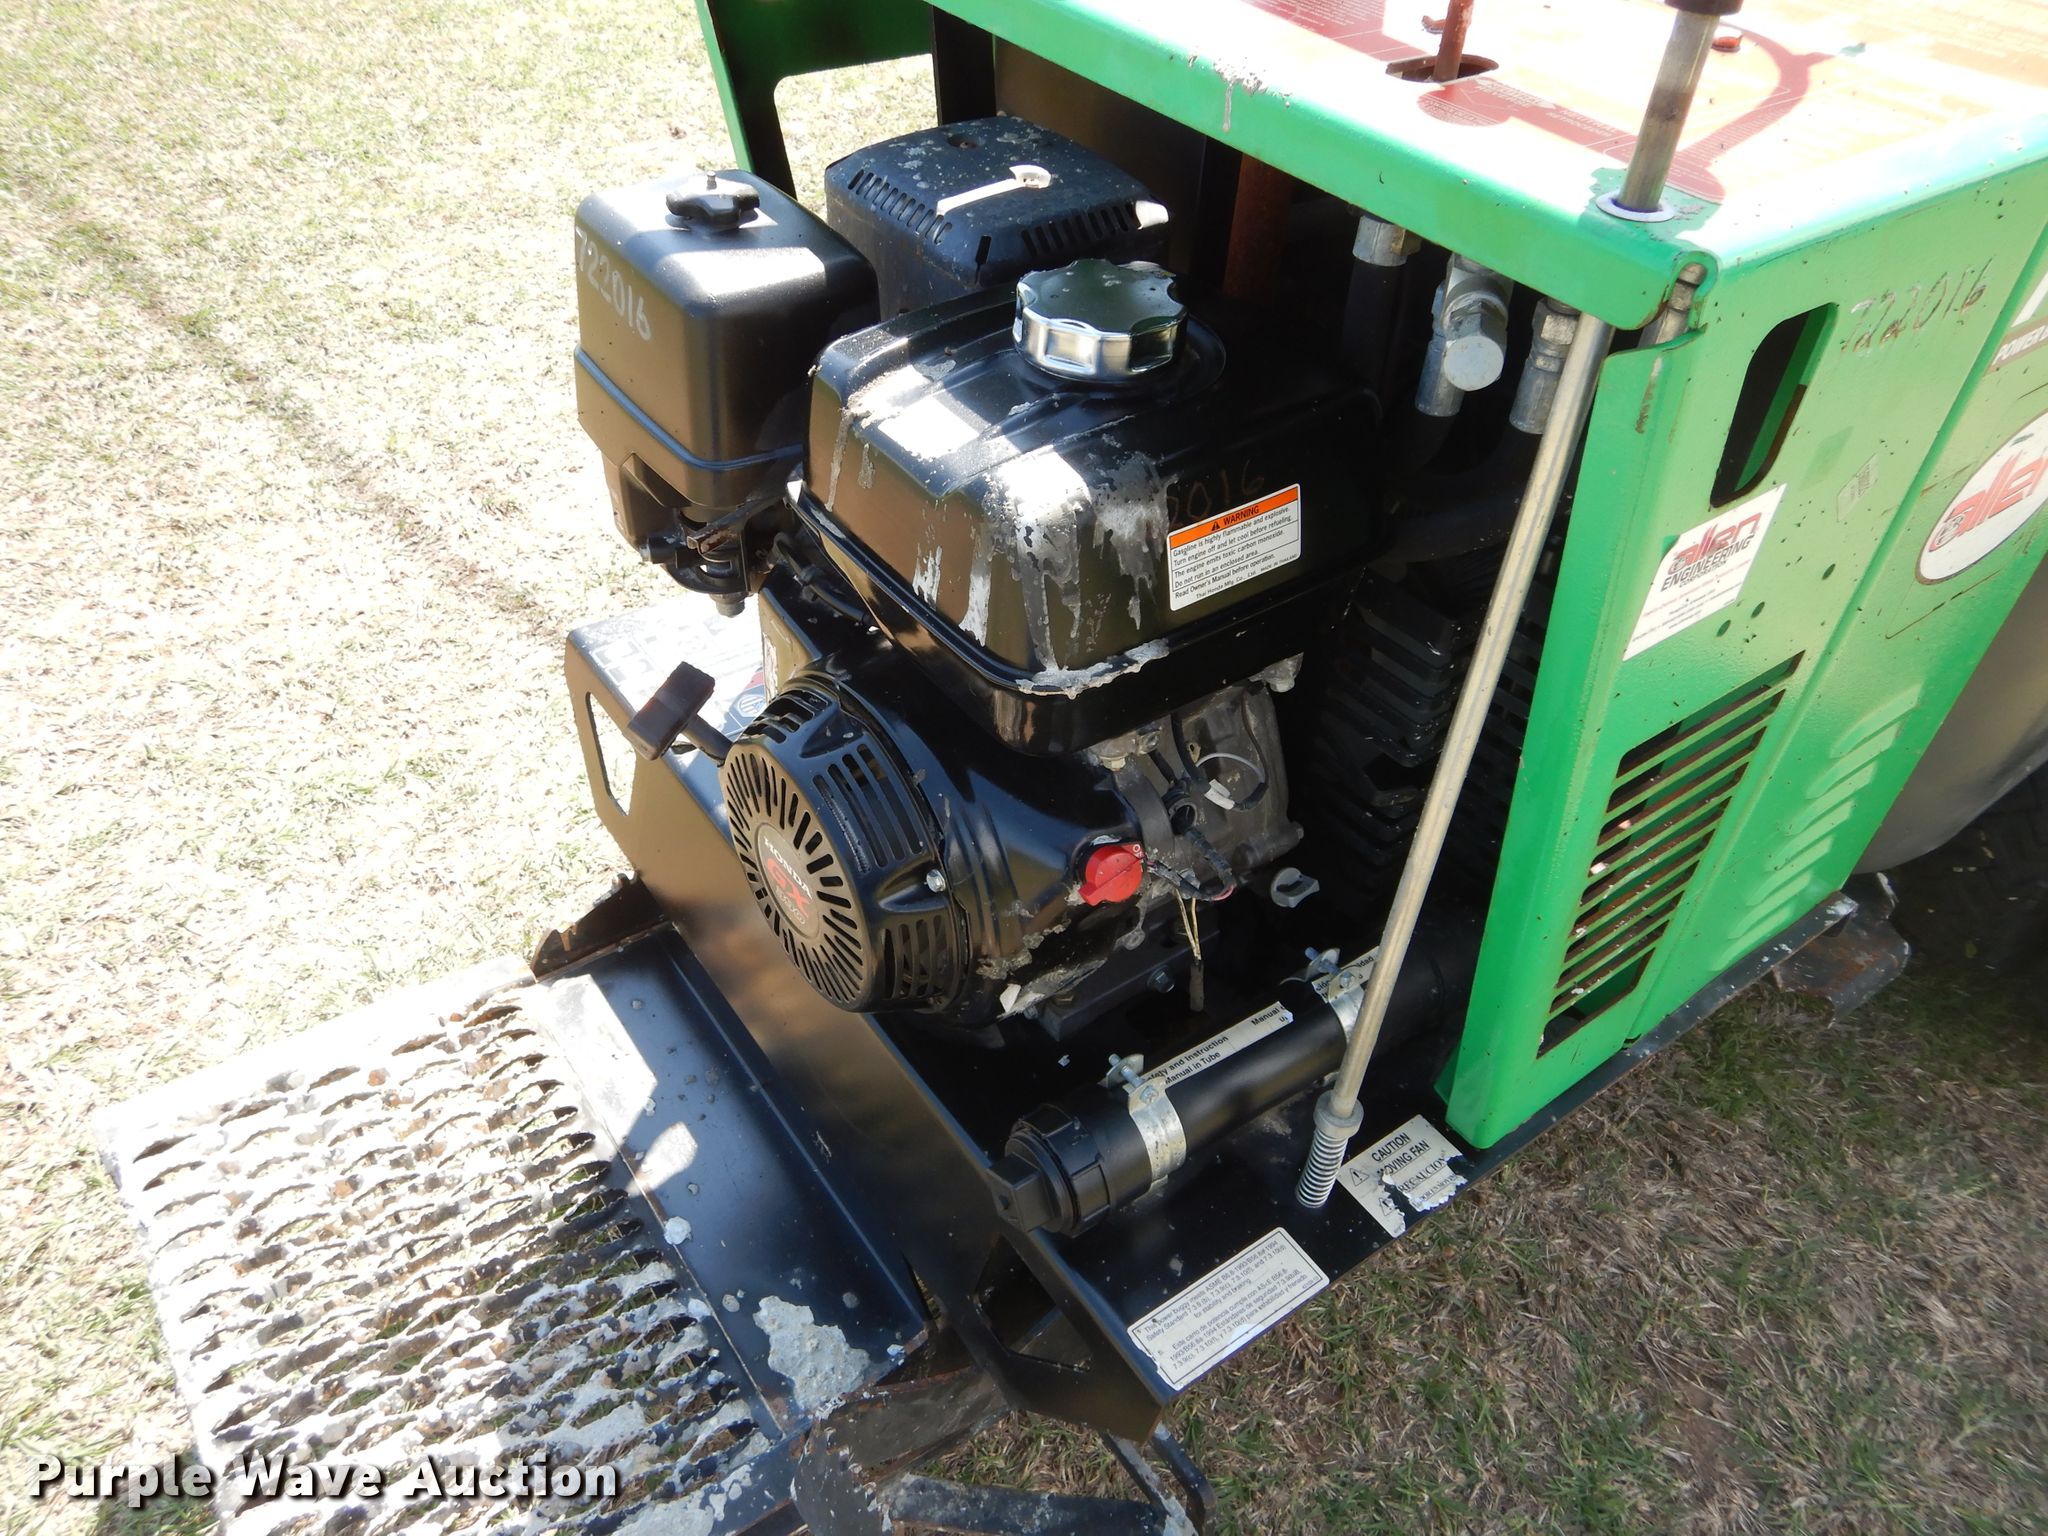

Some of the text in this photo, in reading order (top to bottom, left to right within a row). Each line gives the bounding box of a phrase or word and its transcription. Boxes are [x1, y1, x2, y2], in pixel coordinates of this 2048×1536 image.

[1223, 505, 1259, 526] WARNING
[1173, 542, 1197, 559] Gasoline
[1204, 532, 1221, 545] highly
[1222, 520, 1251, 537] flammable
[1253, 515, 1263, 525] and
[1173, 556, 1186, 566] Turn
[1187, 549, 1206, 562] engine
[1207, 545, 1215, 553] off
[1217, 540, 1227, 549] and
[1237, 532, 1248, 541] cool
[1250, 524, 1267, 536] before
[1174, 569, 1184, 578] The
[1186, 562, 1204, 574] engine
[1206, 554, 1221, 565] emits
[1222, 548, 1236, 559] toxic
[1237, 540, 1256, 552] carbon
[1175, 579, 1182, 588] Do
[1183, 576, 1192, 584] not
[1220, 554, 1244, 569] enclosed
[1660, 534, 1756, 593] ENGINEERING
[1175, 588, 1189, 598] Read
[1189, 579, 1210, 592] Owner's
[1211, 570, 1231, 583] Manual
[1232, 562, 1248, 575] before
[764, 835, 813, 901] HONDA
[767, 857, 811, 919] GX
[1250, 1006, 1280, 1026] Manual
[1165, 1065, 1193, 1085] Manual
[1201, 1051, 1221, 1065] Tube
[1169, 1059, 1185, 1074] and
[1185, 1035, 1229, 1062] Instruction
[1371, 1132, 1411, 1162] CAUTION
[1377, 1140, 1430, 1176] OVING FAN
